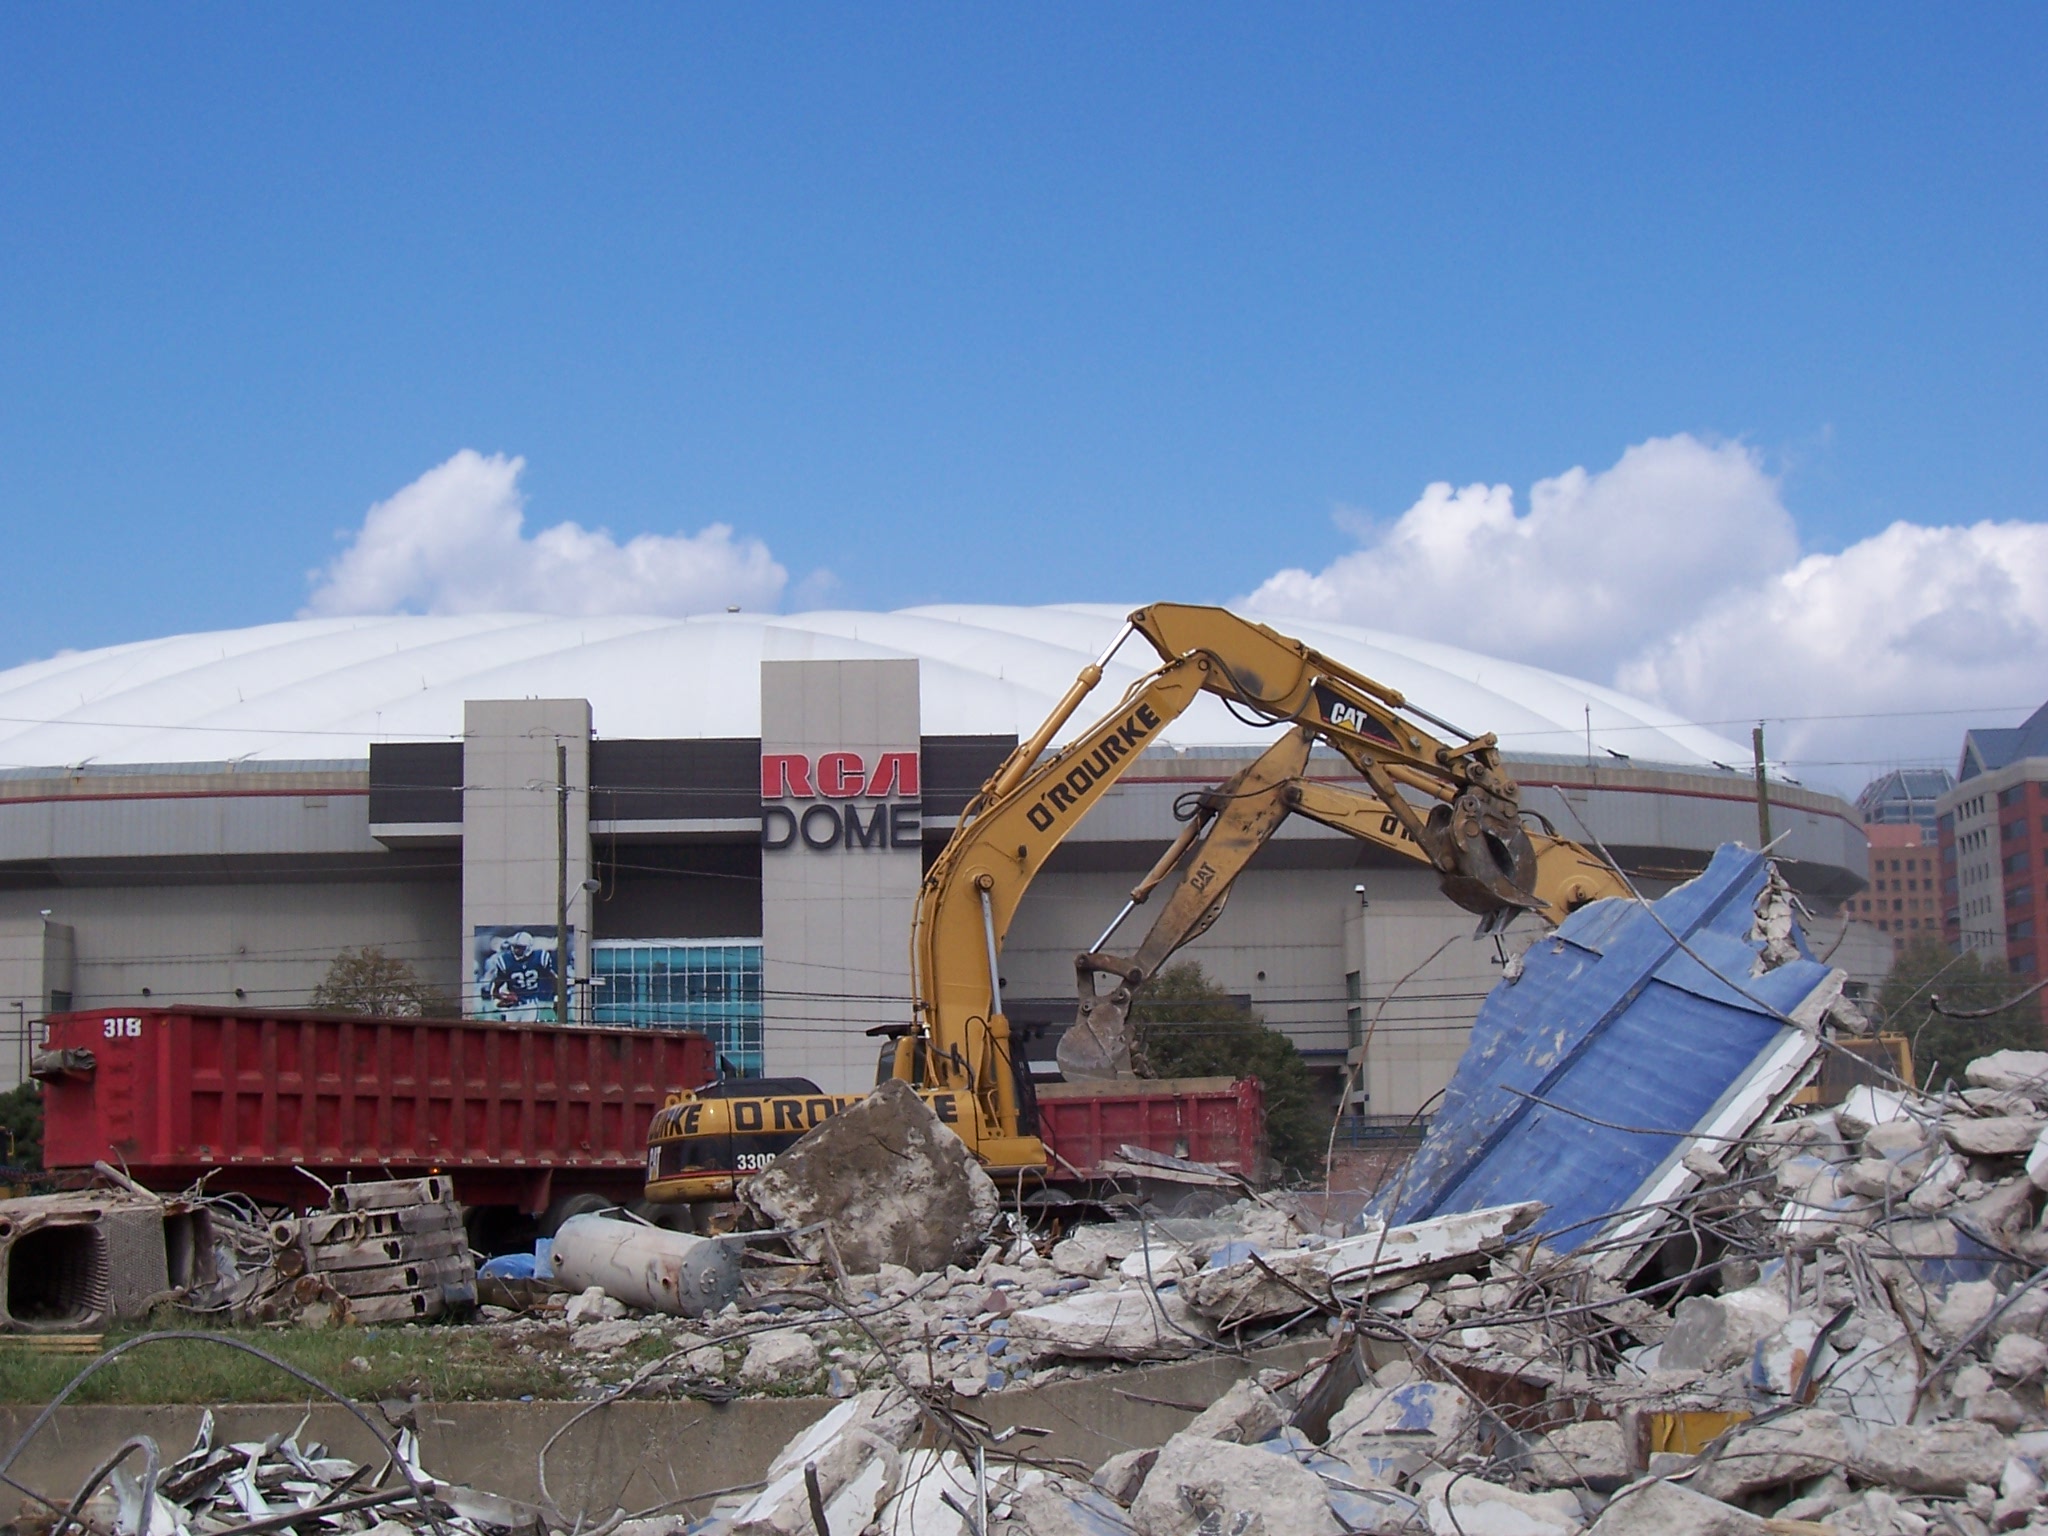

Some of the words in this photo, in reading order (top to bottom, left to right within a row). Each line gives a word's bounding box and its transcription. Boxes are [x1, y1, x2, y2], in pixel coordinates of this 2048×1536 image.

[1330, 702, 1367, 733] CAT
[761, 752, 919, 798] RCA
[1026, 703, 1161, 832] O'ROURKE
[761, 804, 922, 850] DOME
[1190, 861, 1216, 893] CAT
[511, 969, 538, 990] 32
[104, 1018, 142, 1038] 318
